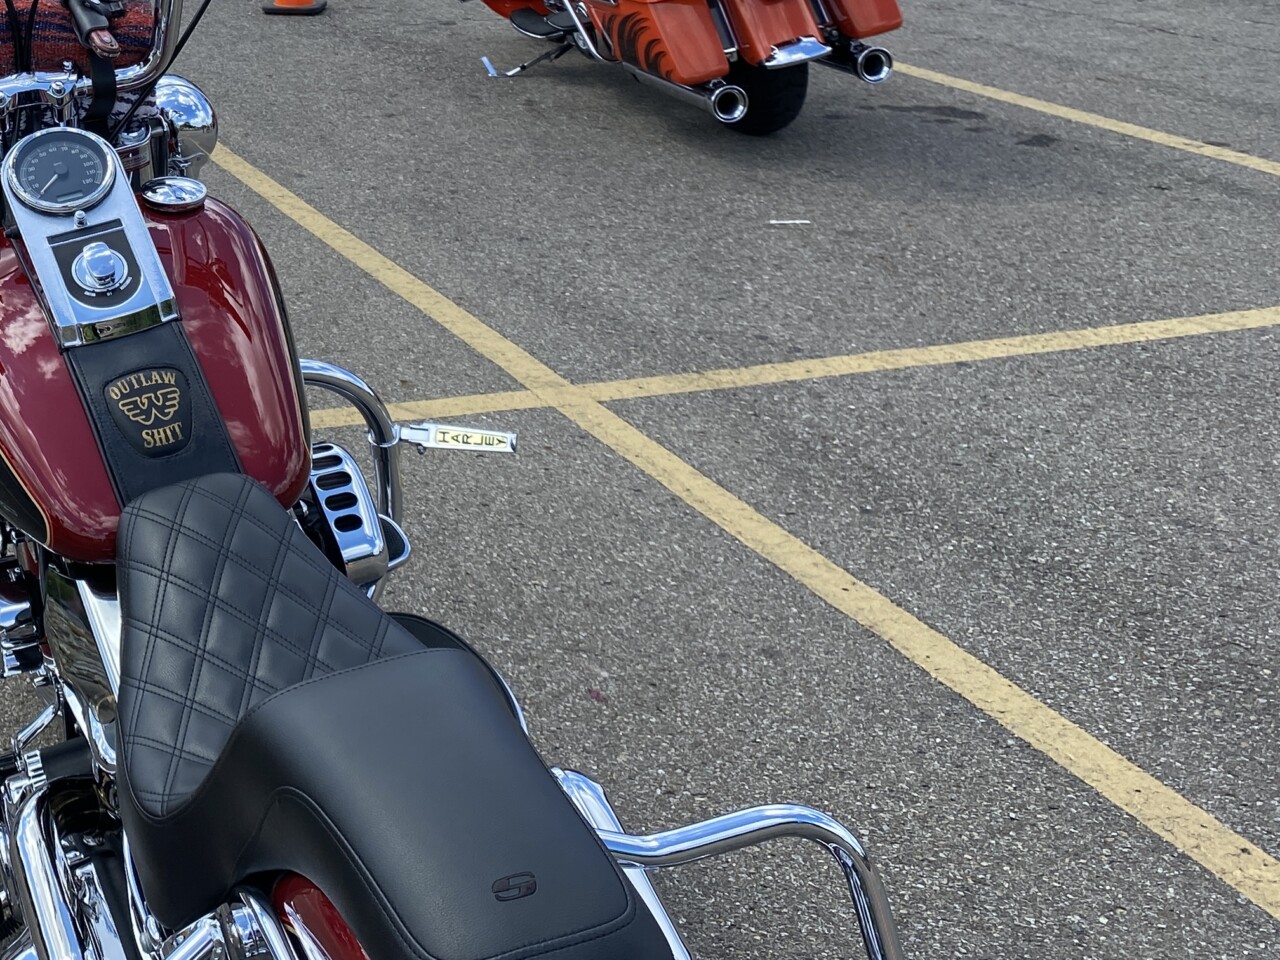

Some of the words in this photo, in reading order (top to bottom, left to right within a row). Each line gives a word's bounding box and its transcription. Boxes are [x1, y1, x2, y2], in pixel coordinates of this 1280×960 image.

[109, 370, 176, 400] OUTLAW
[141, 421, 184, 448] SHIT
[439, 430, 507, 447] HARLEY
